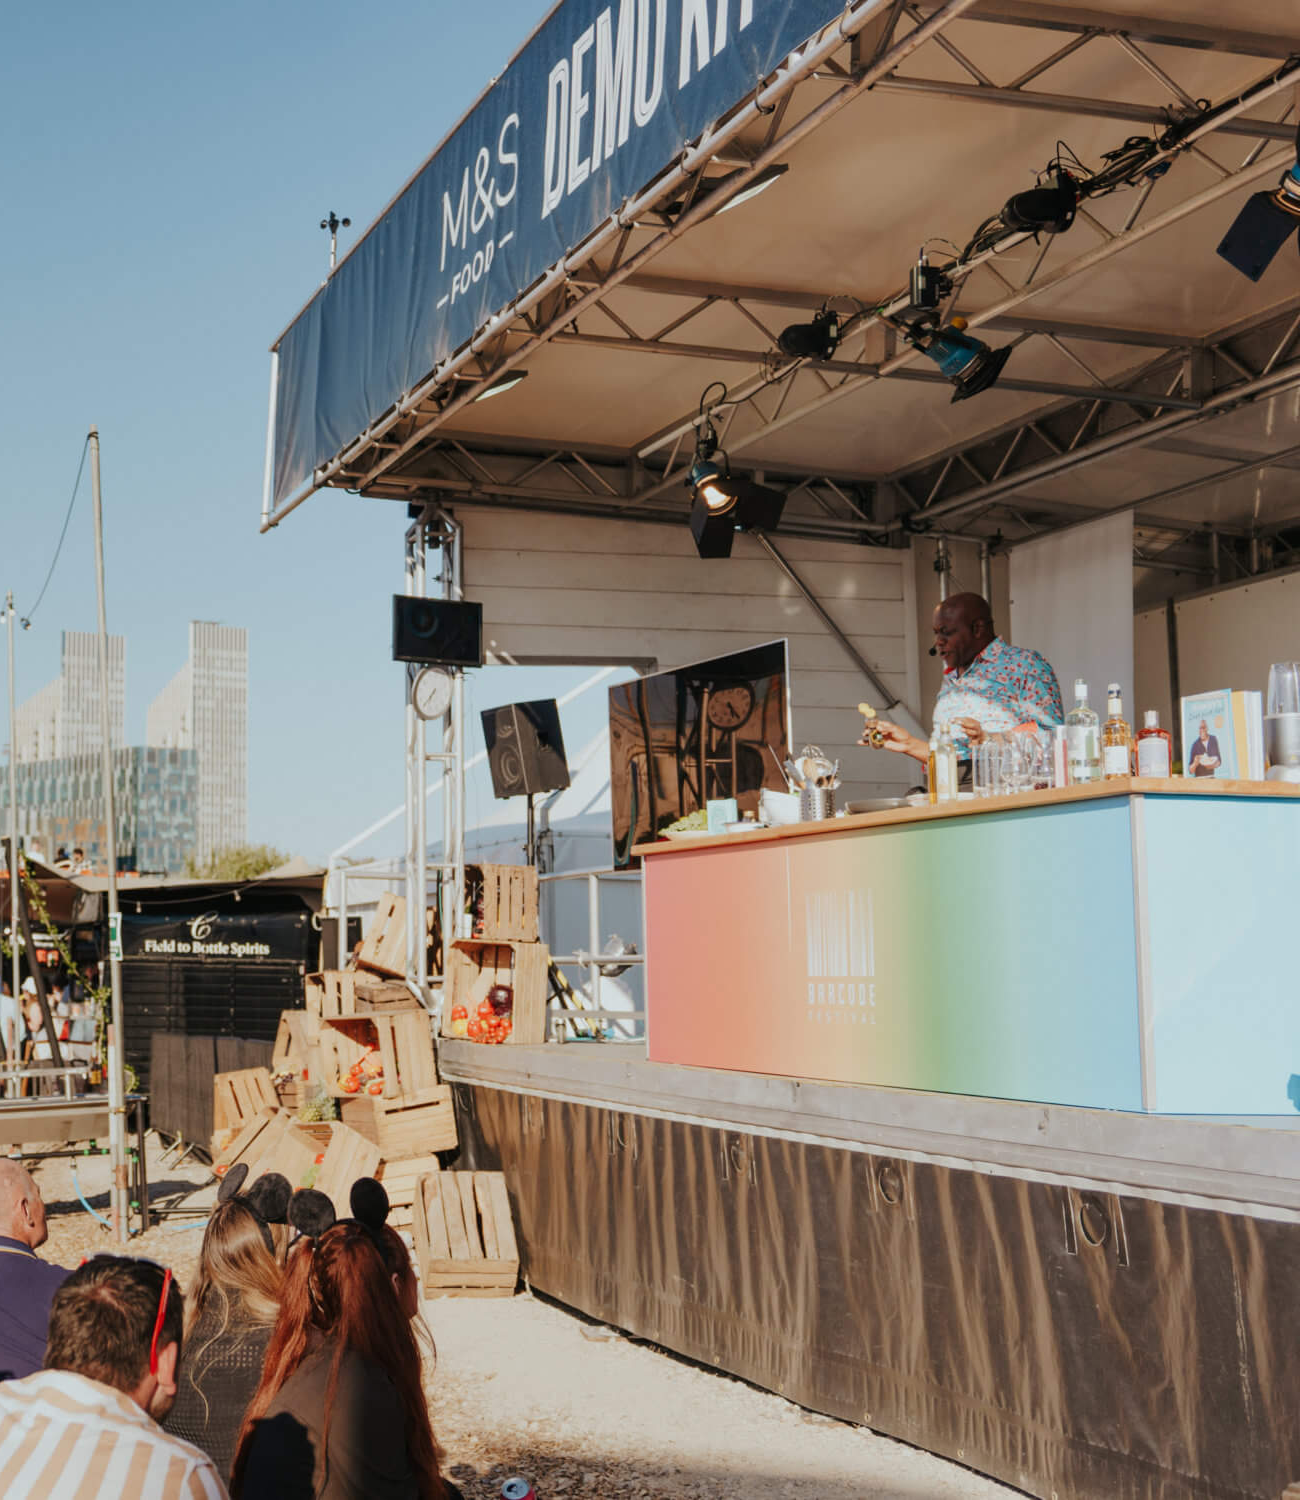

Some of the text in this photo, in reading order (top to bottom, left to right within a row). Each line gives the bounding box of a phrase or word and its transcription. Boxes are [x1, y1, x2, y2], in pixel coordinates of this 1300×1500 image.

[541, 0, 667, 220] DEMO
[440, 113, 519, 272] M&S
[451, 239, 495, 304] FOOD
[145, 939, 270, 958] Field to Bottle Spirits
[808, 983, 876, 1007] BARCODE
